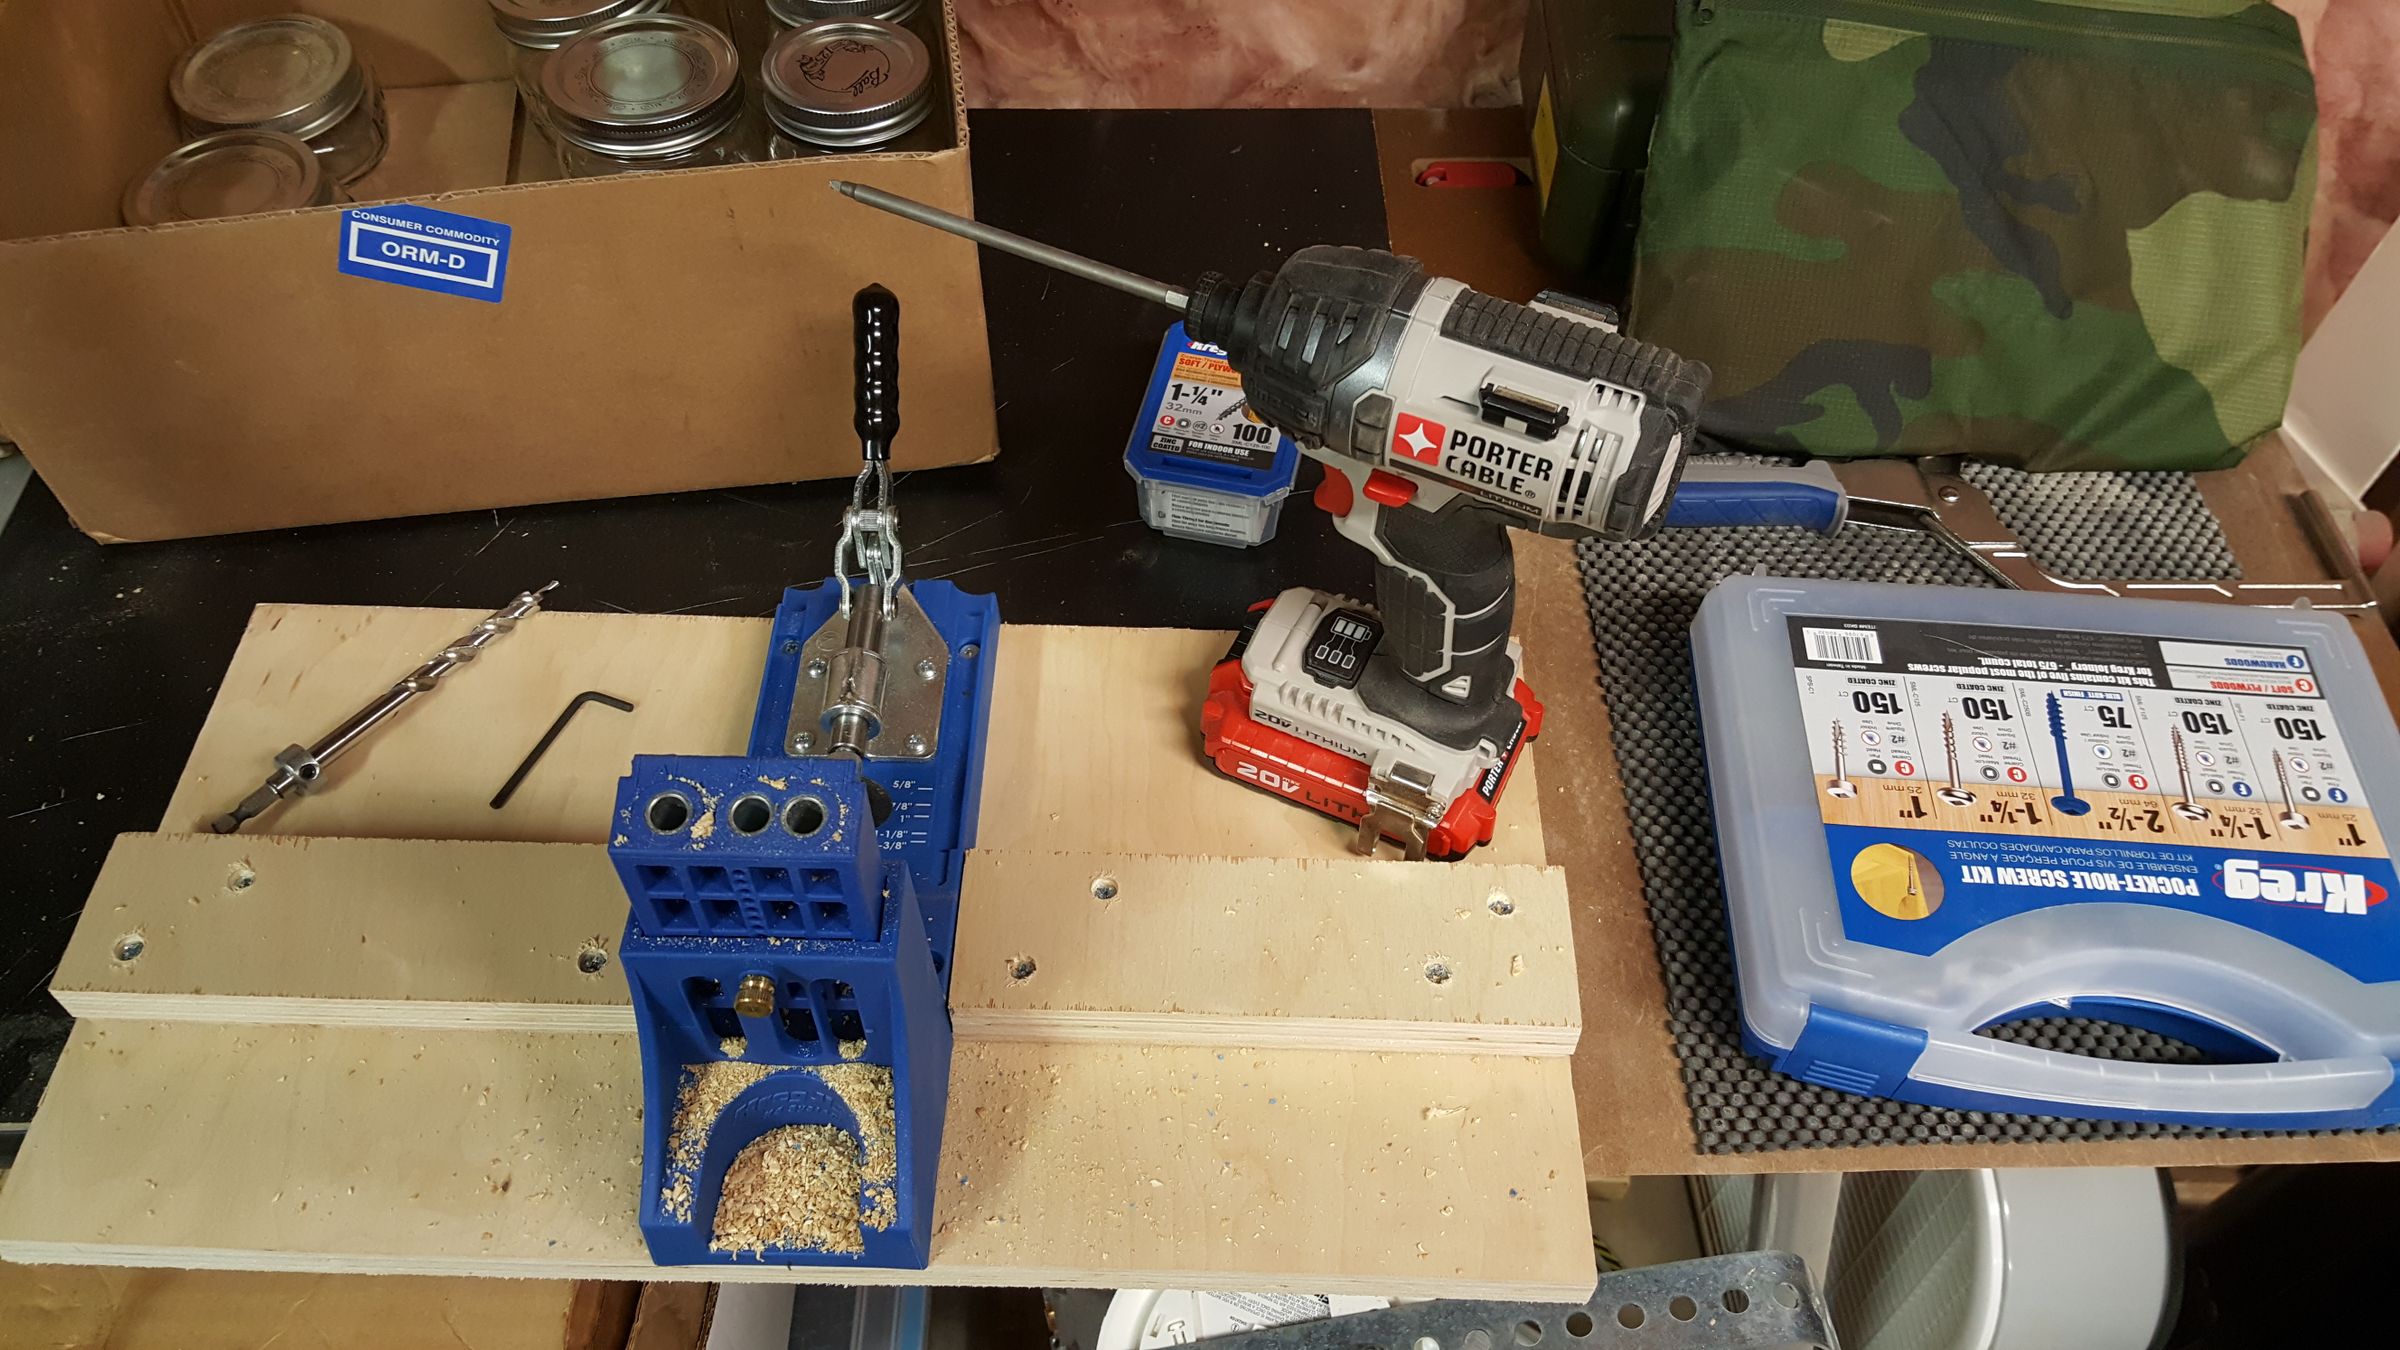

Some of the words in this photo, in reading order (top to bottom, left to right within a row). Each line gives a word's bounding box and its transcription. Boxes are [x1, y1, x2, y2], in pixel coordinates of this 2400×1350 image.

[352, 210, 422, 231] CONSUMER
[425, 225, 500, 246] COMMODITY
[381, 241, 466, 270] ORM-D
[1179, 358, 1200, 368] SOFT
[1232, 423, 1272, 444] 100
[1160, 436, 1177, 445] ZINC
[1153, 442, 1180, 452] COATED
[1188, 440, 1203, 449] FOR
[1204, 443, 1234, 453] INDOOR
[1235, 447, 1250, 457] USE
[1450, 430, 1553, 481] PORTER
[1480, 490, 1541, 514] LITHIUM
[1907, 663, 1946, 672] screws
[2012, 659, 2036, 669] total
[2036, 661, 2058, 671] 675
[2224, 658, 2287, 669] HARDWOODS
[1948, 665, 1989, 676] popular
[1990, 668, 2016, 677] most
[2018, 669, 2036, 679] the
[2037, 671, 2046, 679] of
[2110, 665, 2136, 675] Kreg
[2137, 667, 2153, 677] for
[1847, 677, 1877, 685] COATED
[2047, 672, 2069, 681] five
[2070, 673, 2116, 683] contains
[2118, 676, 2132, 686] kit
[1956, 683, 1985, 691] COATED
[2133, 677, 2157, 687] This
[2210, 681, 2262, 692] PLYWOODS
[2271, 685, 2295, 693] SOFT
[1852, 691, 1903, 715] 150
[2204, 698, 2222, 706] ZINC
[2266, 703, 2295, 711] COATED
[1962, 697, 2013, 721] 150
[2098, 705, 2132, 729] 75
[2182, 710, 2233, 735] 150
[2274, 717, 2326, 741] 150
[1295, 727, 1368, 760] LITHIUM
[1891, 735, 1906, 744] #2
[2002, 742, 2016, 750] #2
[893, 780, 916, 789] 5/8"
[1882, 784, 1905, 792] mm
[1907, 785, 1922, 794] 25
[1899, 795, 1928, 819] 1"
[2144, 801, 2158, 809] 64
[2248, 807, 2263, 815] 32
[900, 814, 910, 823] 1"
[2343, 813, 2357, 822] 25
[2338, 823, 2366, 847] 1"
[878, 841, 907, 851] -3/8"
[1947, 839, 1998, 850] OCULTAS
[2000, 843, 2062, 855] CAVIDADES
[2064, 846, 2093, 856] PARA
[2096, 848, 2157, 860] TORNILLOS
[1950, 851, 1989, 862] ANGLE
[2001, 853, 2059, 866] PERÇAGE
[2062, 856, 2094, 867] POUR
[2159, 852, 2173, 861] DE
[2176, 853, 2193, 862] KIT
[2097, 858, 2116, 868] VIS
[2119, 860, 2134, 870] DE
[2137, 861, 2198, 873] ENSEMBLE
[1962, 865, 1994, 884] KIT
[1998, 866, 2070, 889] SCREW
[2074, 871, 2200, 896] POCKET-HOLE
[2224, 858, 2368, 915] Kreg
